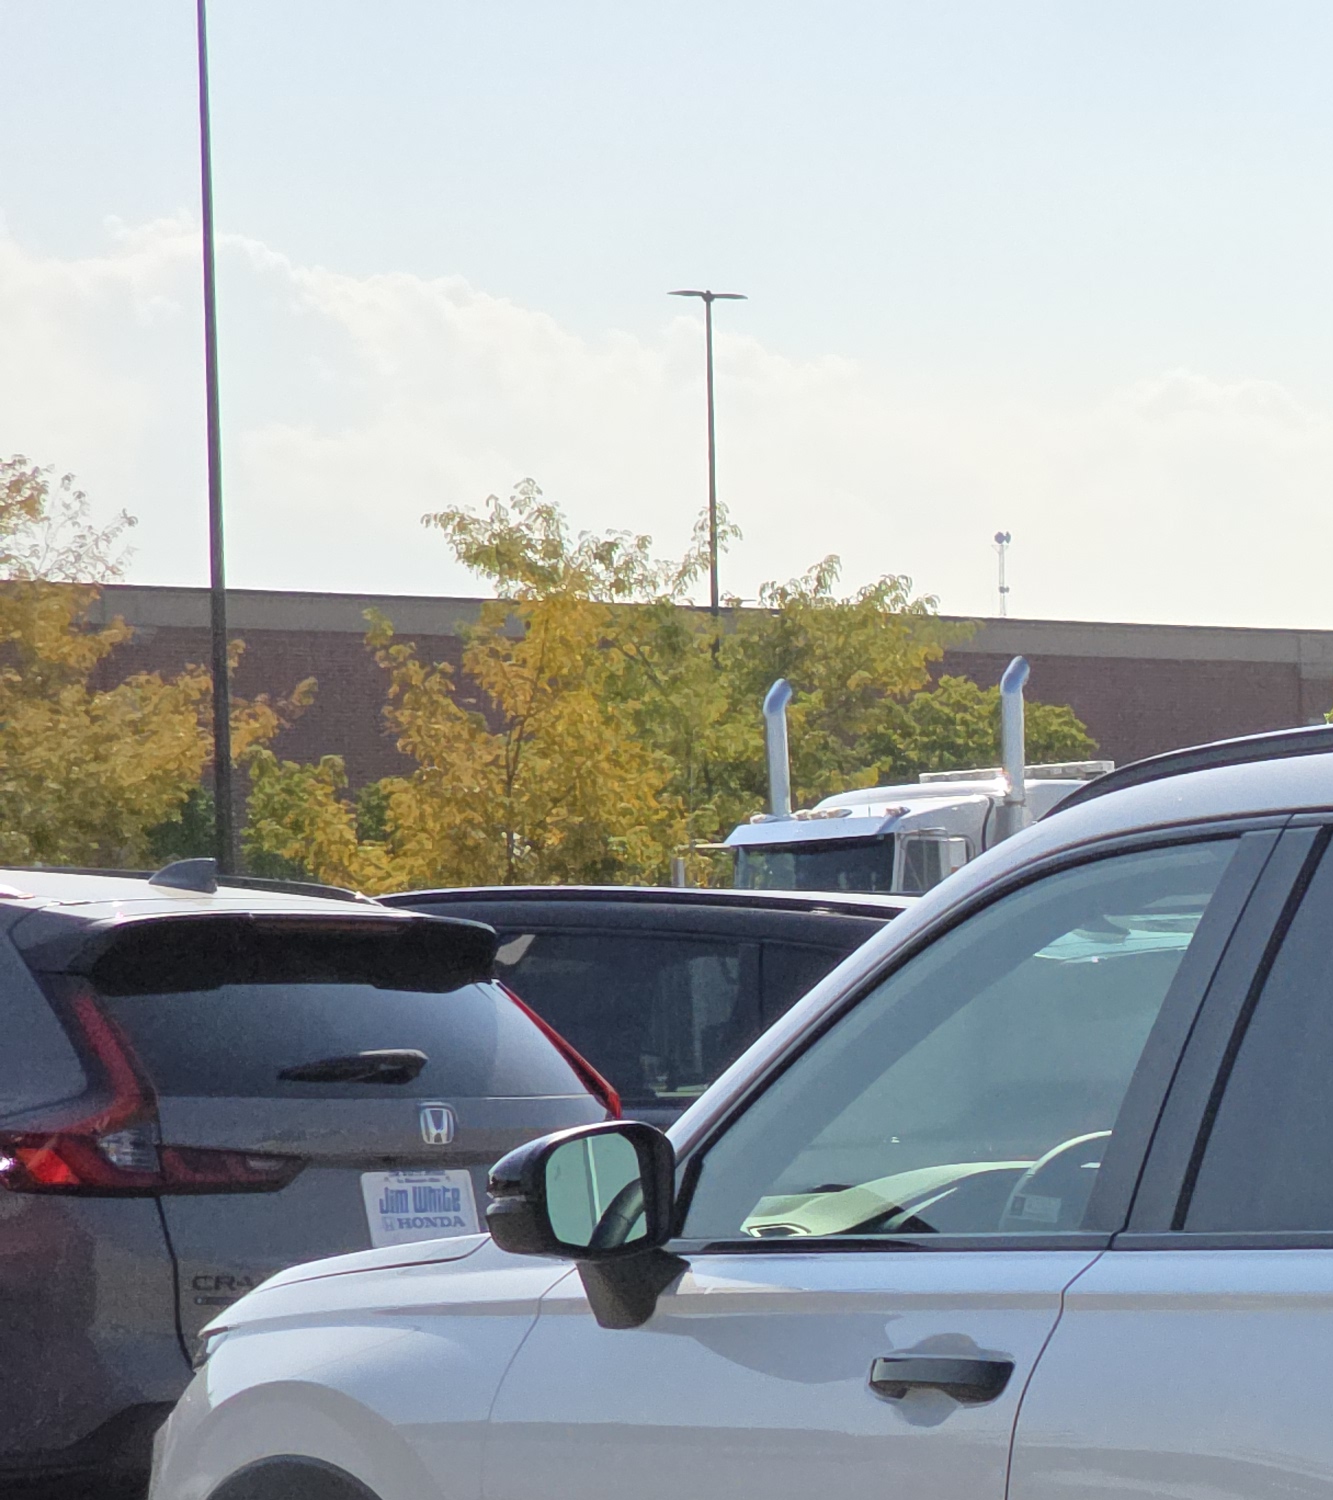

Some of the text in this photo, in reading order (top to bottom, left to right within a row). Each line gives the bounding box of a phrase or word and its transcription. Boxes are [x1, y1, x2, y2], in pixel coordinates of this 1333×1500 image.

[379, 1185, 461, 1214] Jim White
[397, 1216, 466, 1229] HONDA
